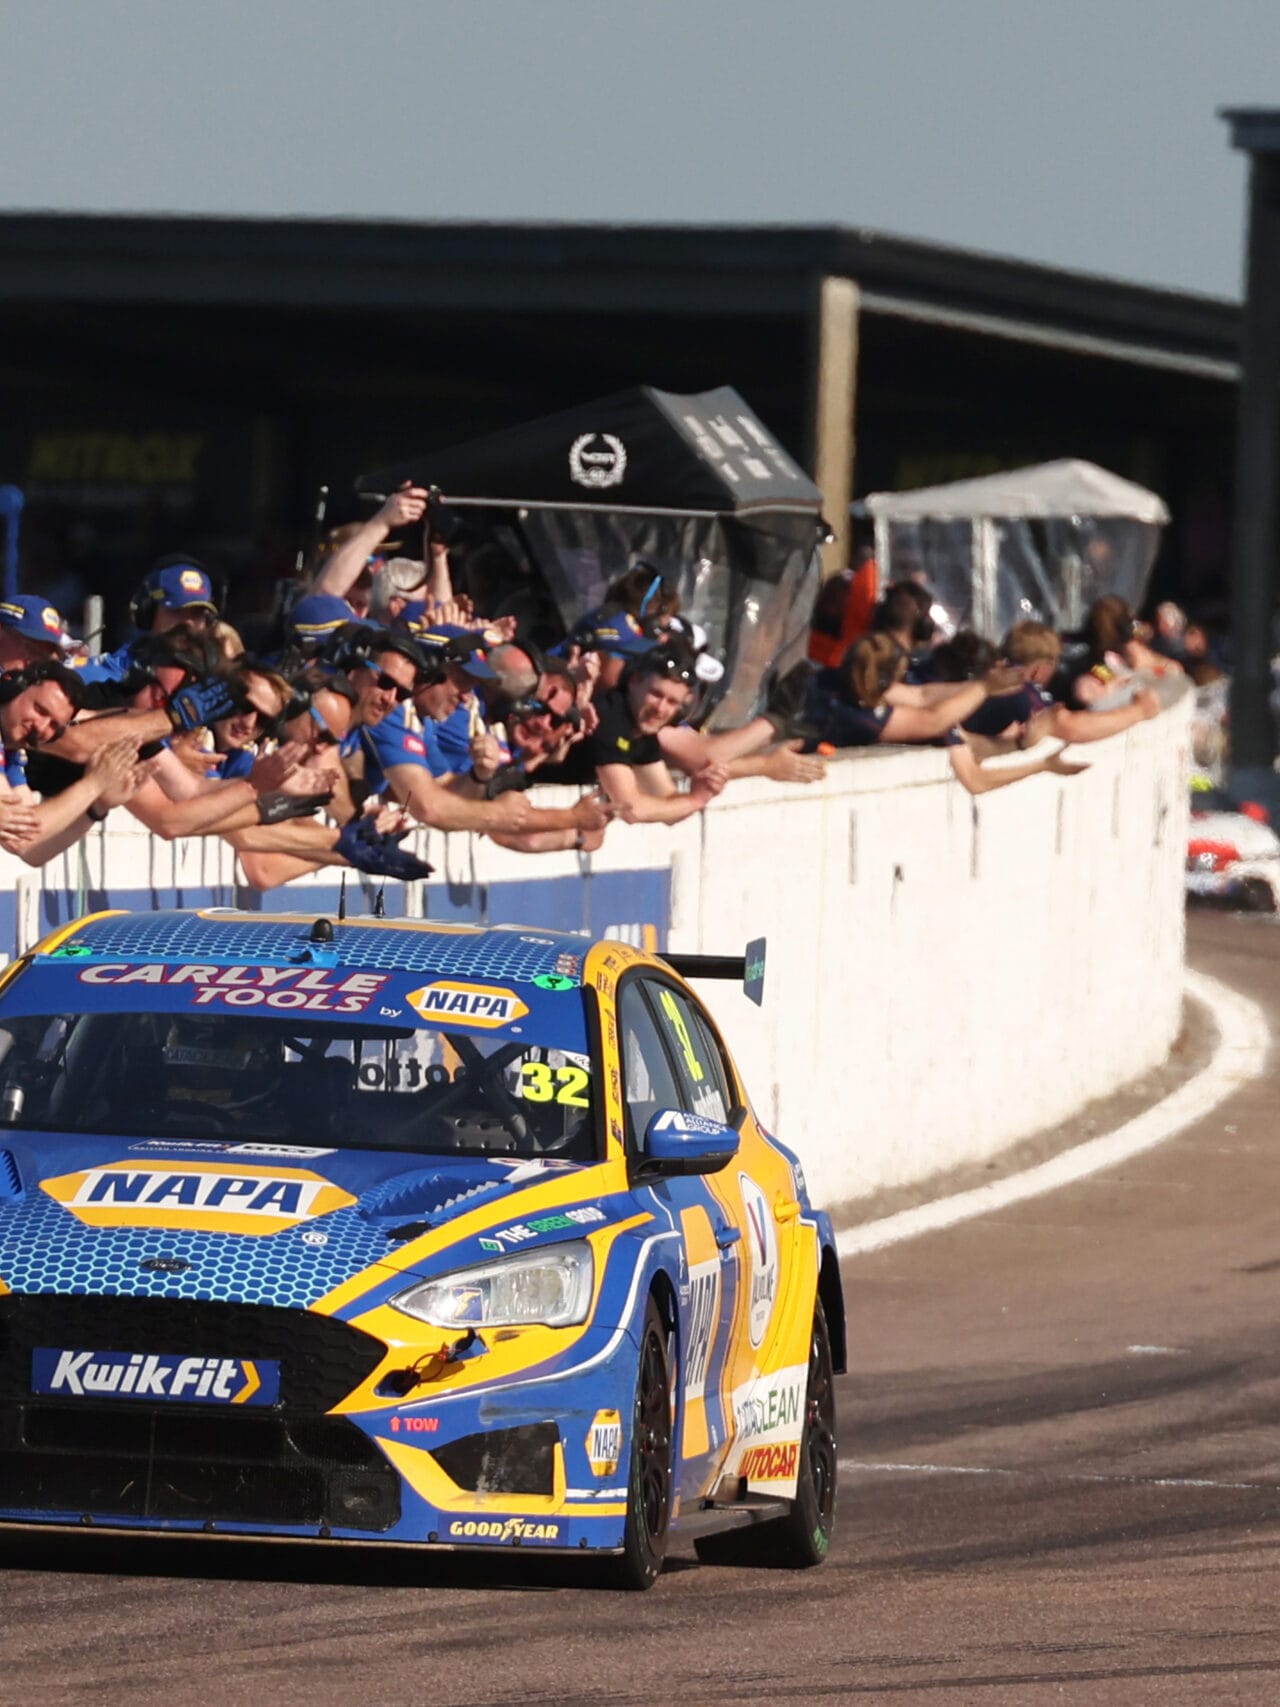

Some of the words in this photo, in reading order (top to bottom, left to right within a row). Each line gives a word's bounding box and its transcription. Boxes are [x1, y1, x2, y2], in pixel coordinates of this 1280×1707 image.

[79, 964, 390, 993] CARLYLE
[193, 987, 374, 1012] TOOLS
[380, 1005, 402, 1018] by
[424, 990, 510, 1019] NAPA
[521, 1062, 590, 1108] 32
[86, 1172, 306, 1214] NAPA
[404, 1417, 439, 1432] TOW
[594, 1425, 619, 1459] NAPA
[449, 1517, 560, 1542] GOODYEAR
